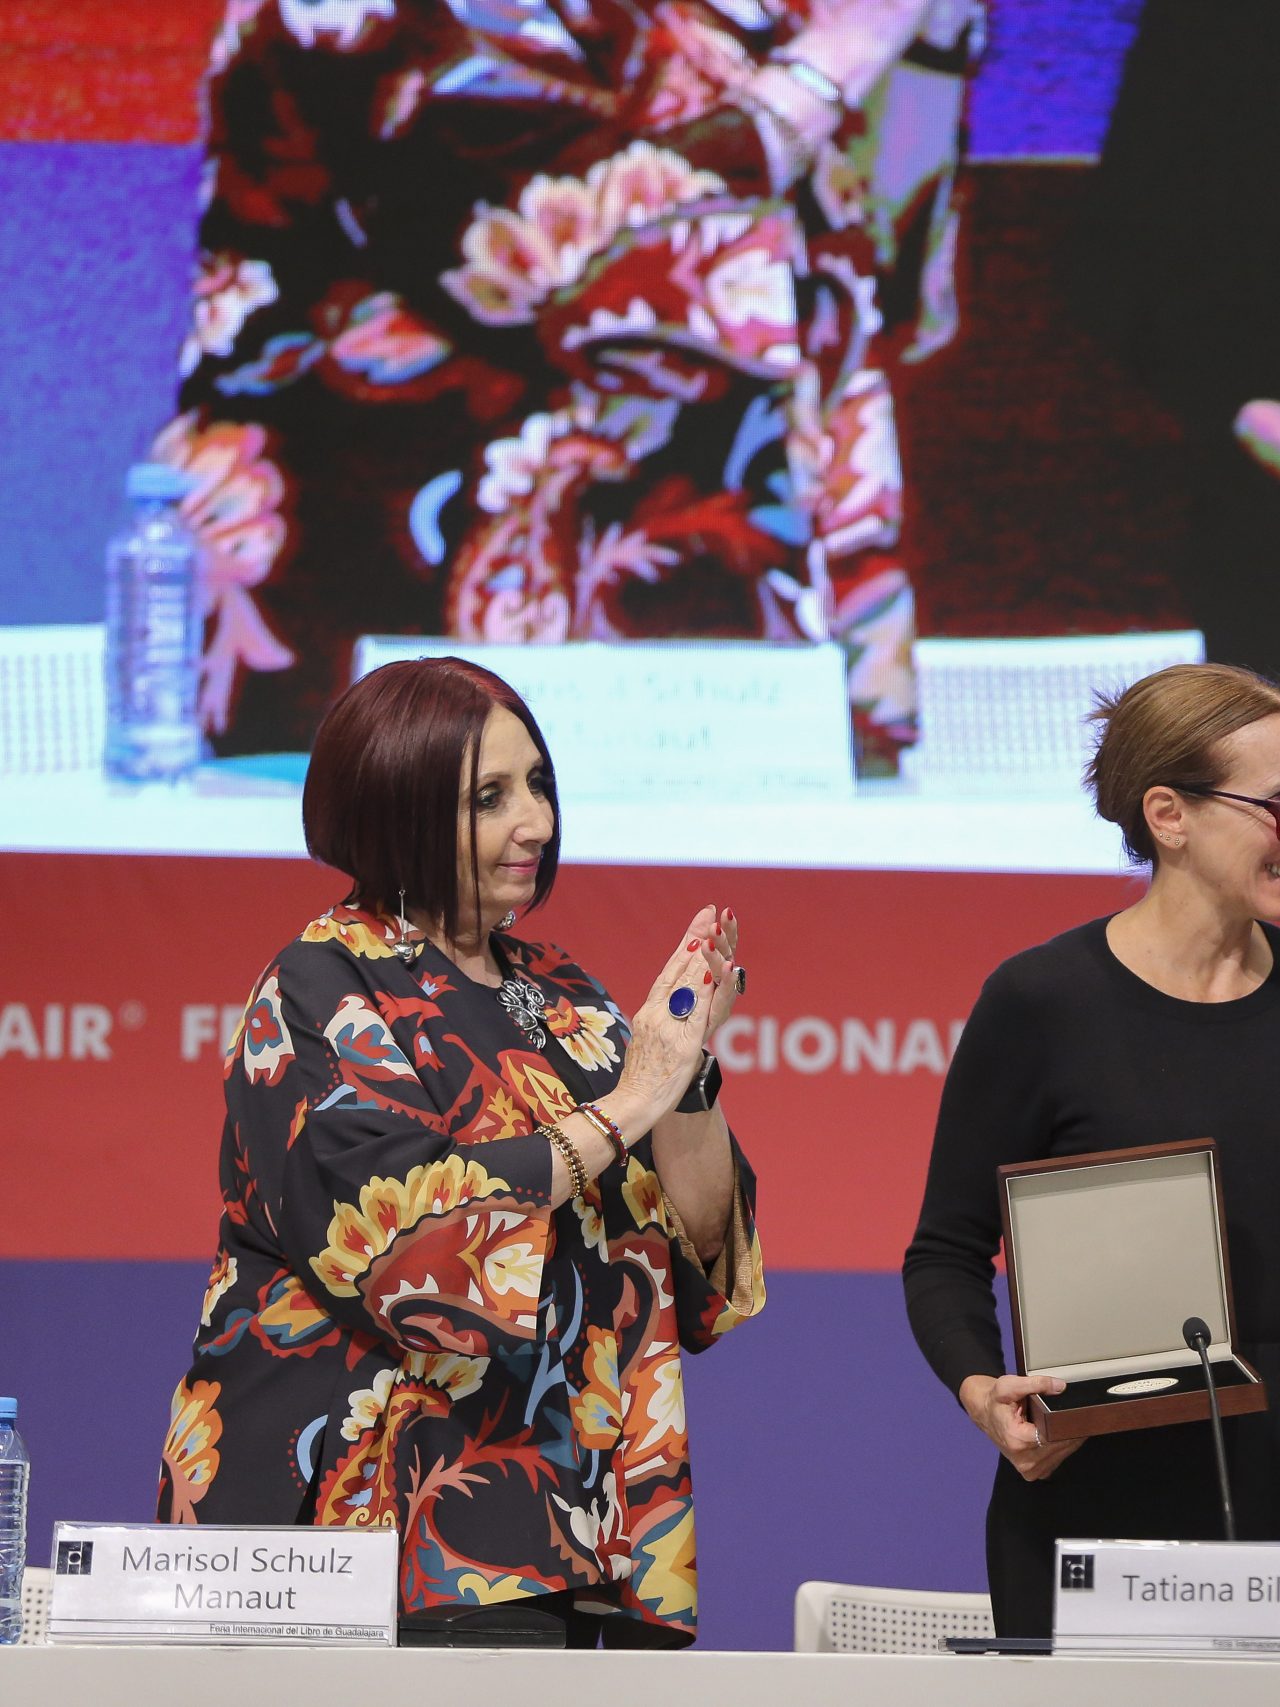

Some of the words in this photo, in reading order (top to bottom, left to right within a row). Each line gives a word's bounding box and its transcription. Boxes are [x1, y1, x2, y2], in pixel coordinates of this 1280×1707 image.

[122, 1546, 238, 1573] Marisol
[251, 1547, 353, 1574] Schulz
[174, 1584, 296, 1610] Manaut
[1122, 1574, 1234, 1602] Tatiana
[210, 1624, 230, 1633] Feria
[233, 1624, 283, 1634] Internacional
[286, 1626, 298, 1635] del
[300, 1626, 320, 1636] Libro
[322, 1627, 333, 1636] de
[335, 1628, 383, 1638] Guadalajara
